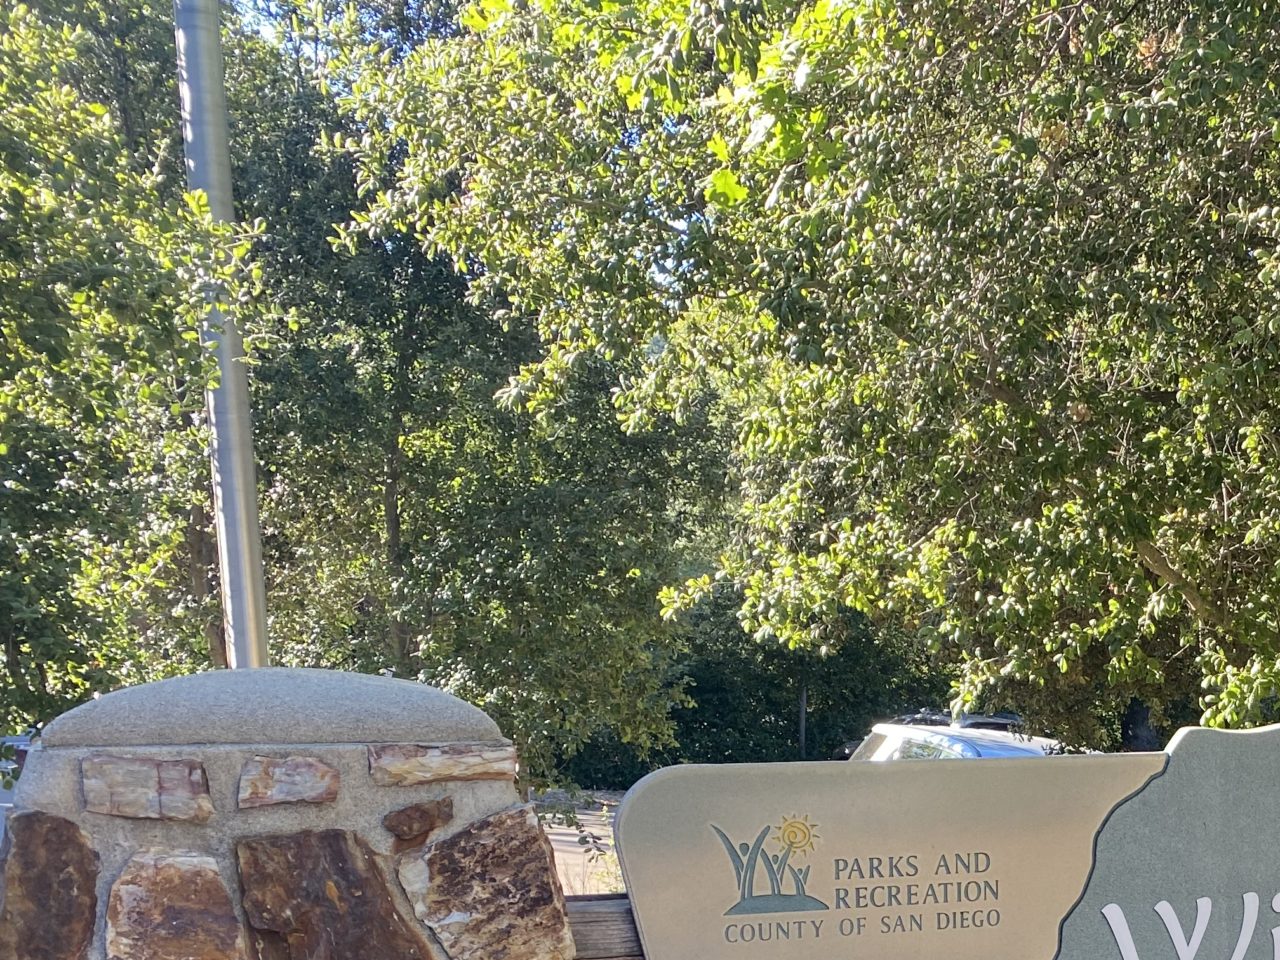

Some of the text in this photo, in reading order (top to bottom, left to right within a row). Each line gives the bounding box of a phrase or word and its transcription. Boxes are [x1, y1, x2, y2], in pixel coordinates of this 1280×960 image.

[833, 851, 992, 880] PARKS AND
[834, 879, 1000, 910] RECREATION
[724, 908, 1001, 943] COUNTY OF SAN DIEGO
